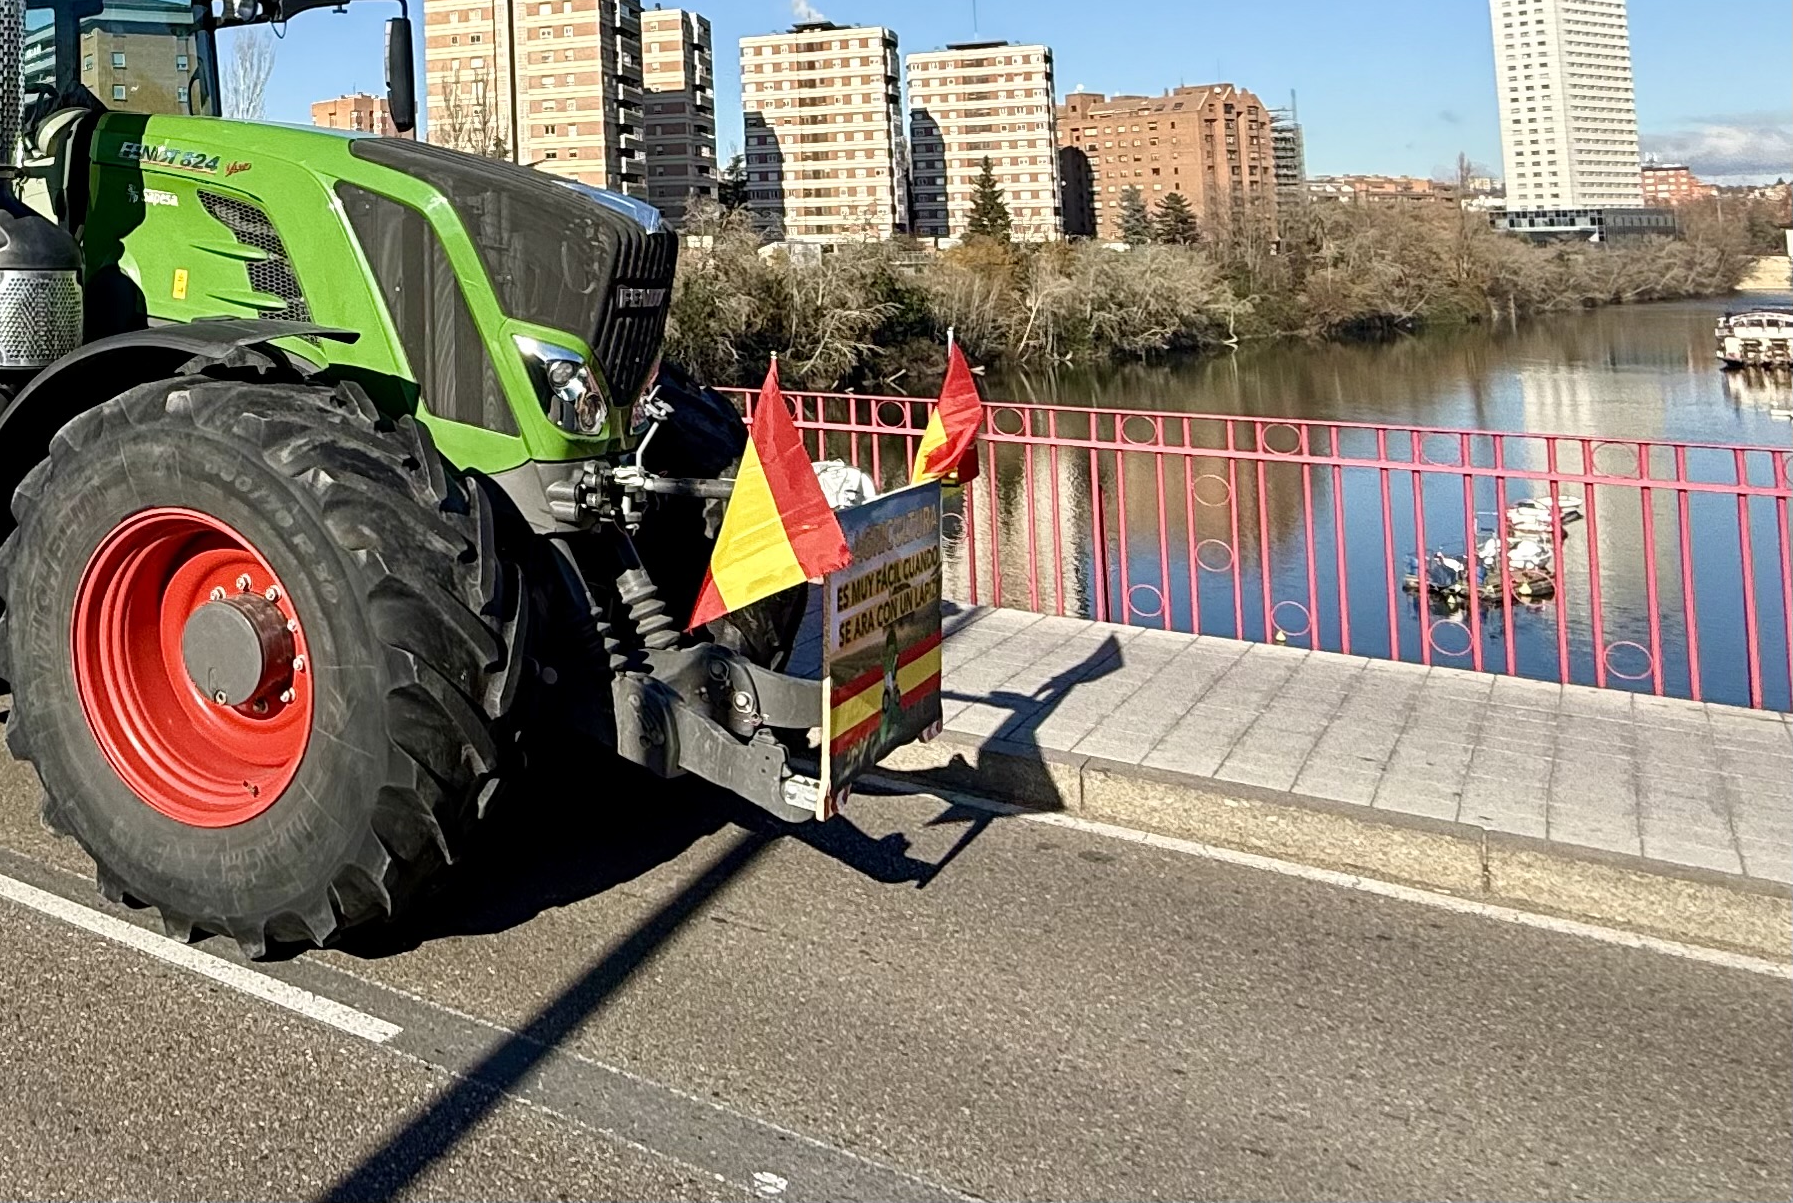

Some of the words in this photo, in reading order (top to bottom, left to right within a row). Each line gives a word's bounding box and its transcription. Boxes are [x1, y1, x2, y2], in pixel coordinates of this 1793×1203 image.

[837, 583, 849, 613] ES
[851, 571, 874, 607] MUY
[903, 545, 938, 580] CUANDO
[838, 619, 851, 648] SE
[854, 609, 875, 641] ARA
[877, 598, 898, 628] CON
[899, 591, 913, 615] UN
